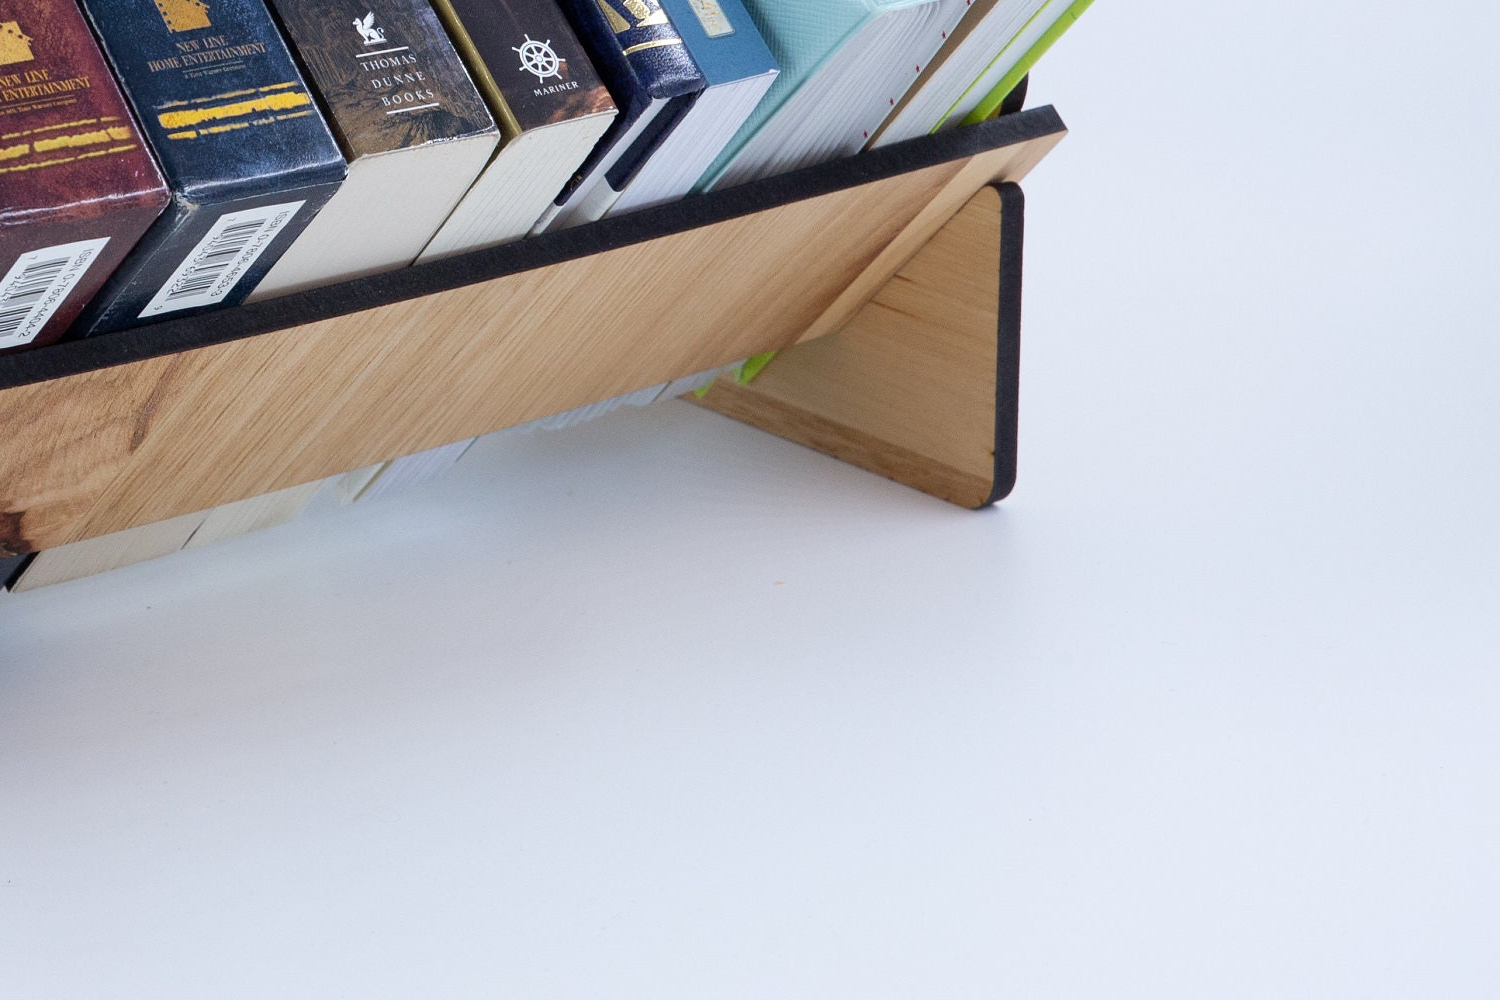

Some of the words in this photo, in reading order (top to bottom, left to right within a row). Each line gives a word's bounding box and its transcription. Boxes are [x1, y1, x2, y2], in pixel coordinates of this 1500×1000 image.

[176, 39, 201, 55] NEW
[203, 35, 229, 48] LINE
[147, 55, 182, 73] HOME
[180, 42, 267, 67] ENTERTAINMENT
[361, 53, 417, 71] THOMAS
[24, 69, 51, 83] LINE
[370, 72, 426, 89] DUNNE
[0, 76, 91, 102] ENTERTAINMENT
[381, 88, 435, 107] BOOKS
[533, 80, 579, 97] MARINER
[264, 210, 289, 233] ISBN
[69, 248, 94, 271] ISBN
